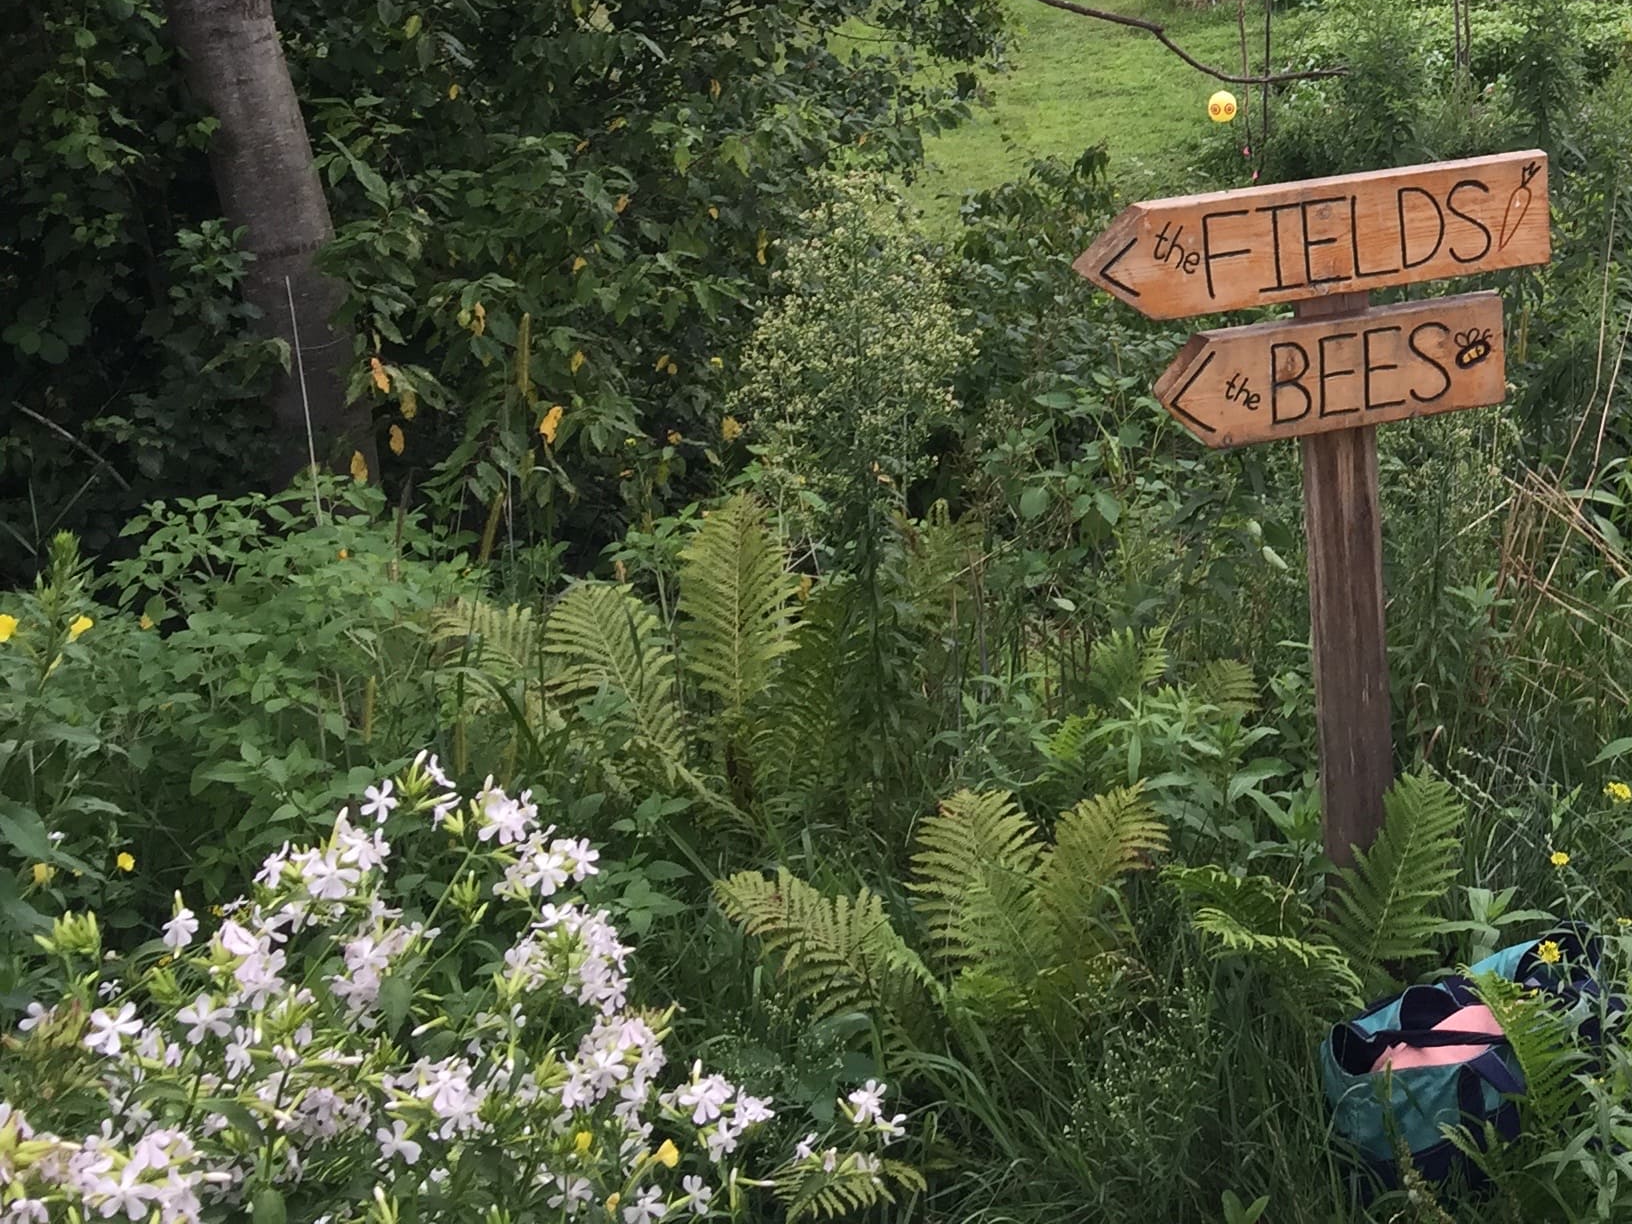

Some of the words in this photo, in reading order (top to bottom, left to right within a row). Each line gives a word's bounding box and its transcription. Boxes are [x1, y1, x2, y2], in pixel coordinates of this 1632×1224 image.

[1154, 221, 1200, 275] the
[1201, 179, 1492, 299] FIELDS
[1225, 372, 1261, 411] the
[1271, 321, 1451, 425] BEES
